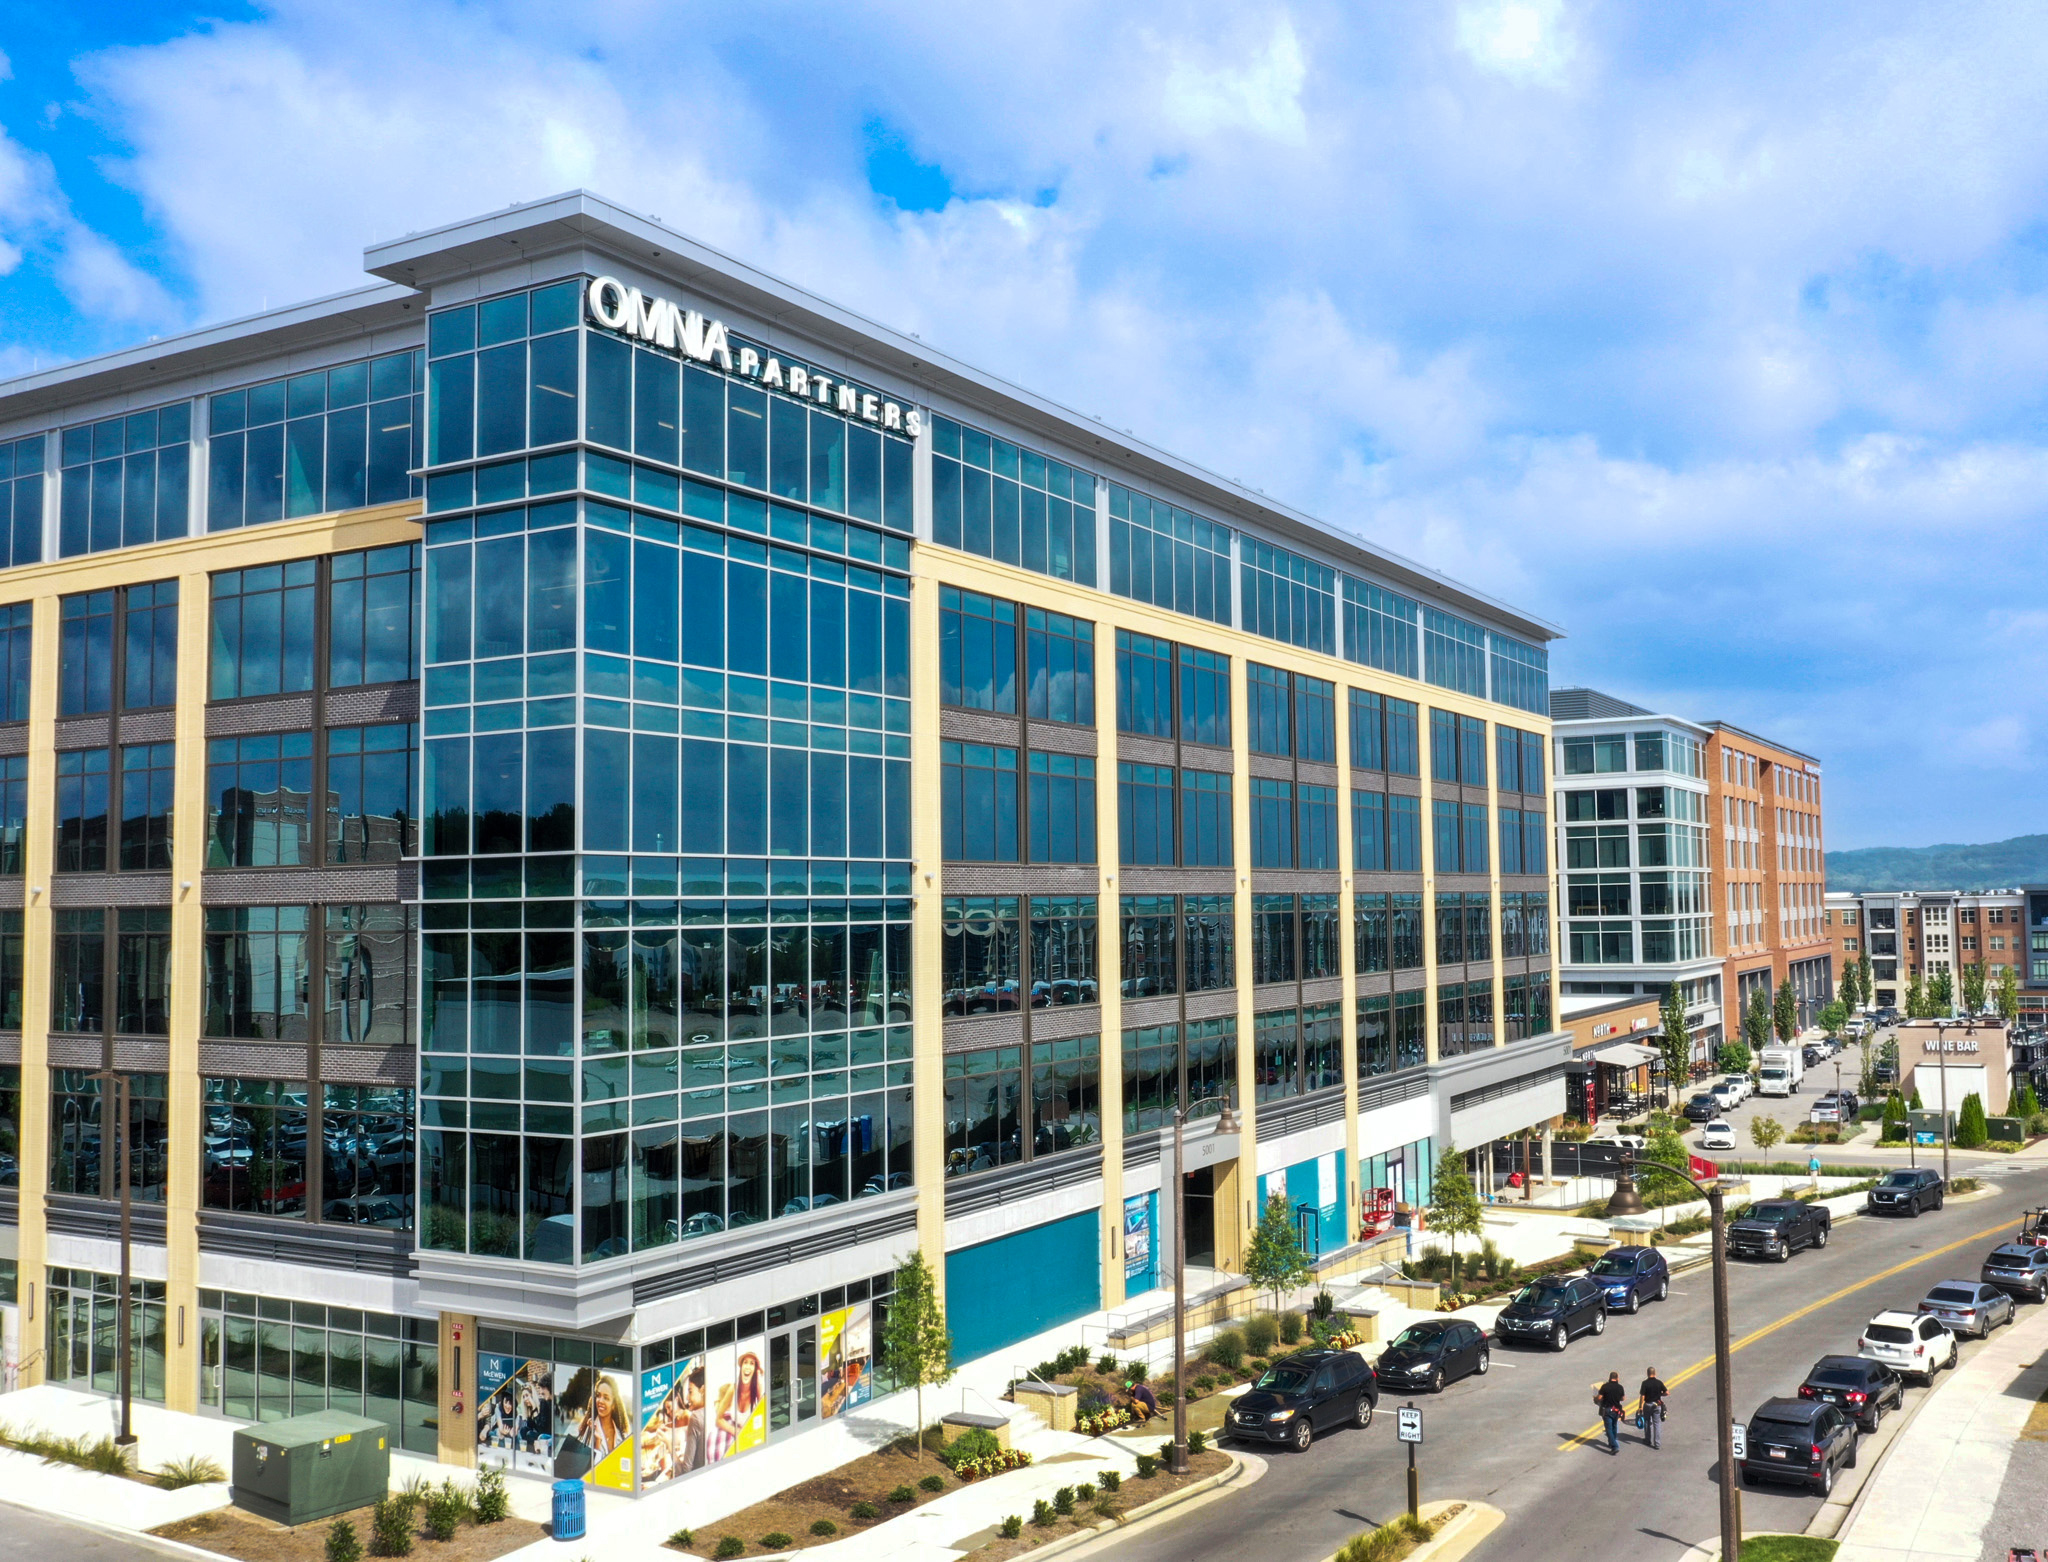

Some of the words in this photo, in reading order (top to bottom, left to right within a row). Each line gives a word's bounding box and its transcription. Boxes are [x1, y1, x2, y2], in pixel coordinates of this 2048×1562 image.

[740, 347, 921, 437] PARTNERS
[1925, 1040, 1955, 1051] WINE
[1957, 1040, 1979, 1052] BAR
[1202, 1143, 1215, 1157] 5001
[1401, 1411, 1419, 1419] KEEP
[1400, 1431, 1420, 1440] RIGHT
[1734, 1442, 1744, 1455] 5
